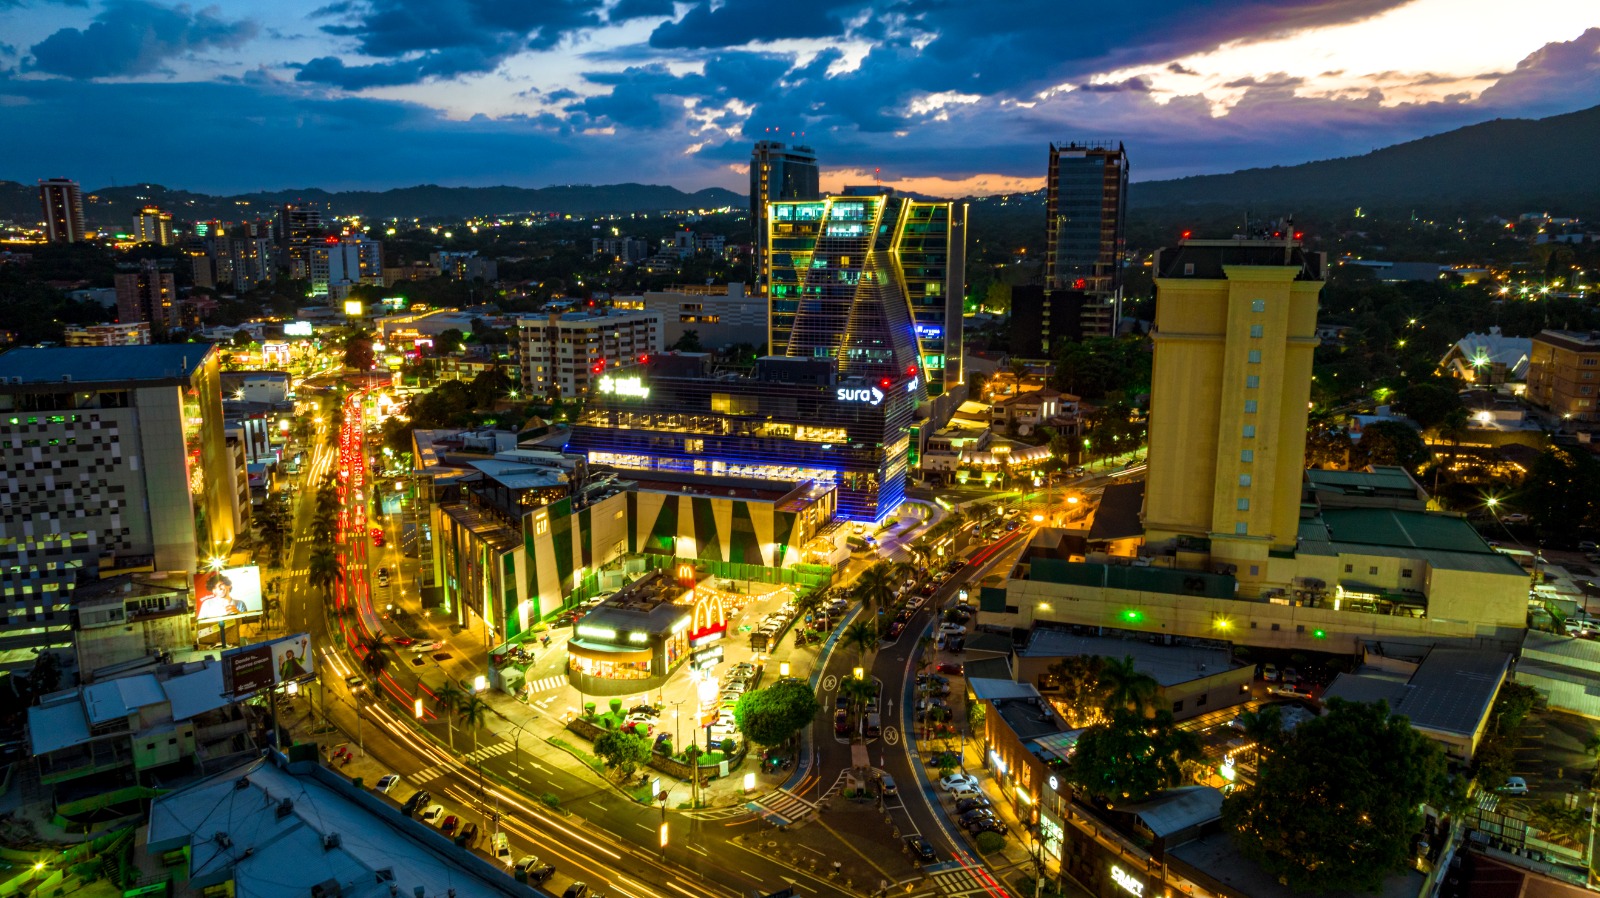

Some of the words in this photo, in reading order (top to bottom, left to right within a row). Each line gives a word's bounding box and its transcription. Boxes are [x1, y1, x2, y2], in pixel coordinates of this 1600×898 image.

[837, 388, 871, 402] sura
[886, 730, 897, 741] 30
[1111, 865, 1144, 894] CRAFT
